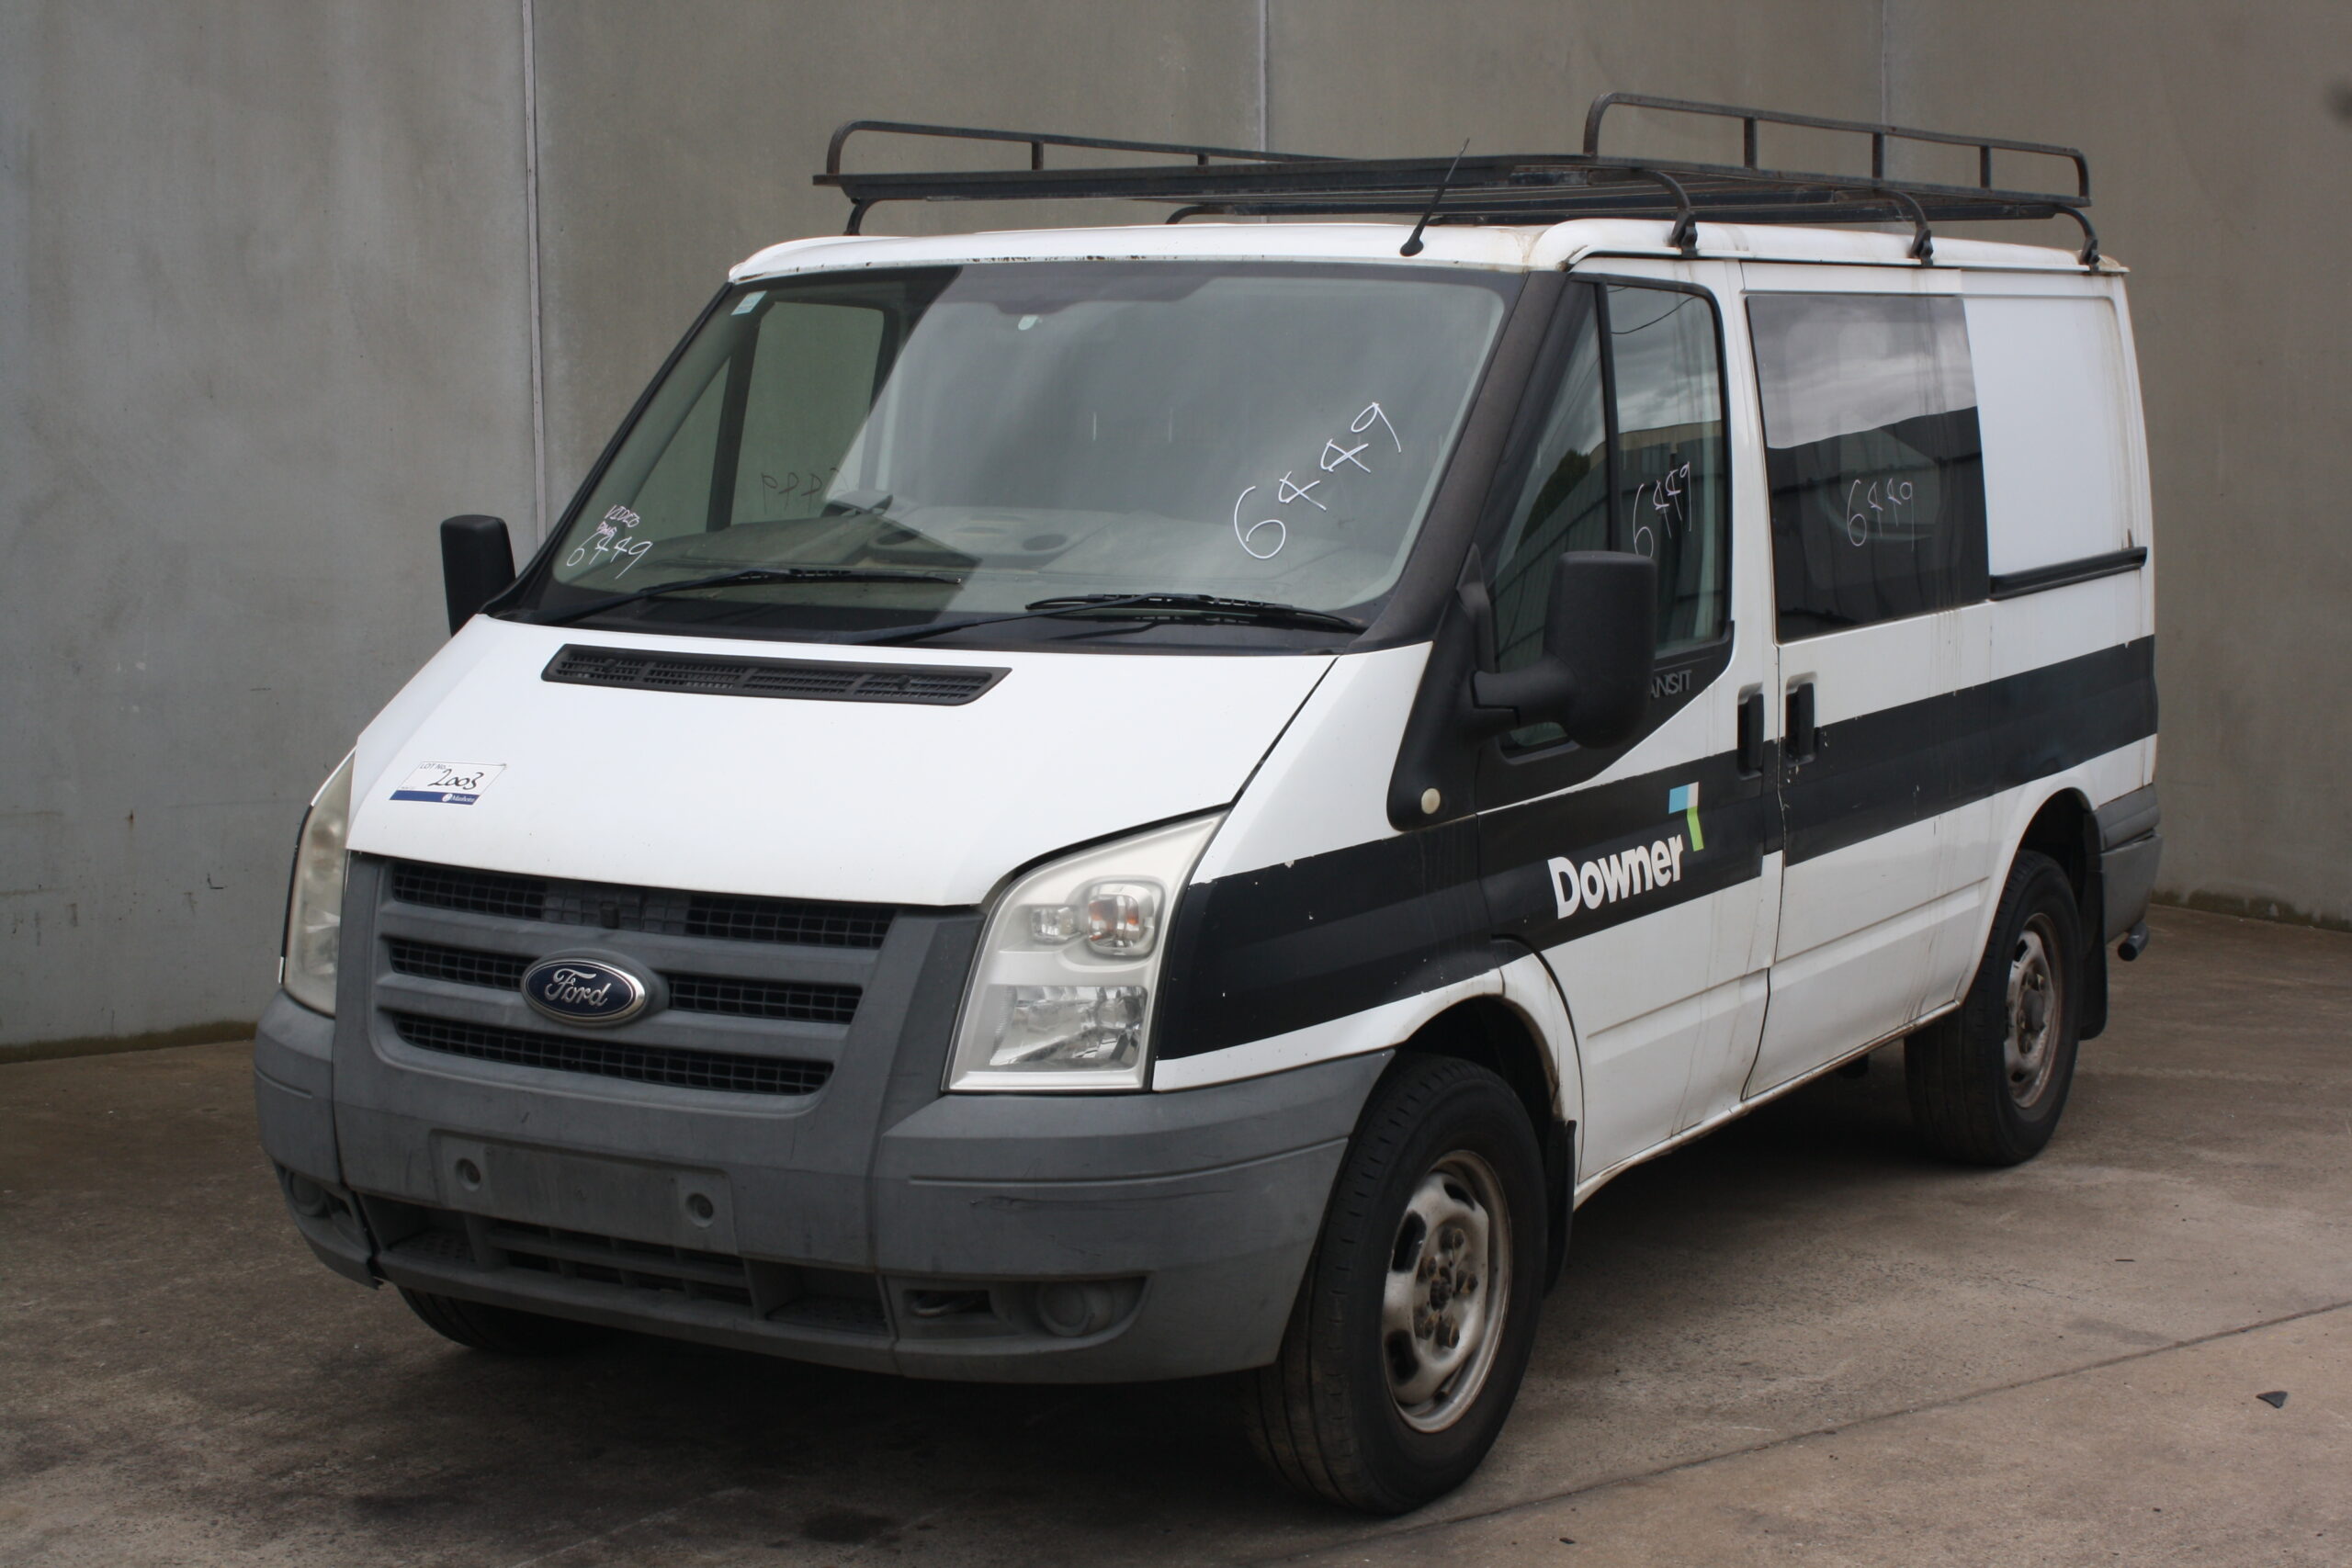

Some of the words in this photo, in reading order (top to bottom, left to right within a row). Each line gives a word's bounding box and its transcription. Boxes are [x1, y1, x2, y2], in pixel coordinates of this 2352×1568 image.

[1233, 401, 1402, 559] 6449
[1633, 460, 1692, 558] 6449
[1847, 478, 1916, 552] 6449
[427, 768, 485, 791] 2003
[1547, 834, 1684, 919] Downer
[544, 967, 612, 1007] Ford
